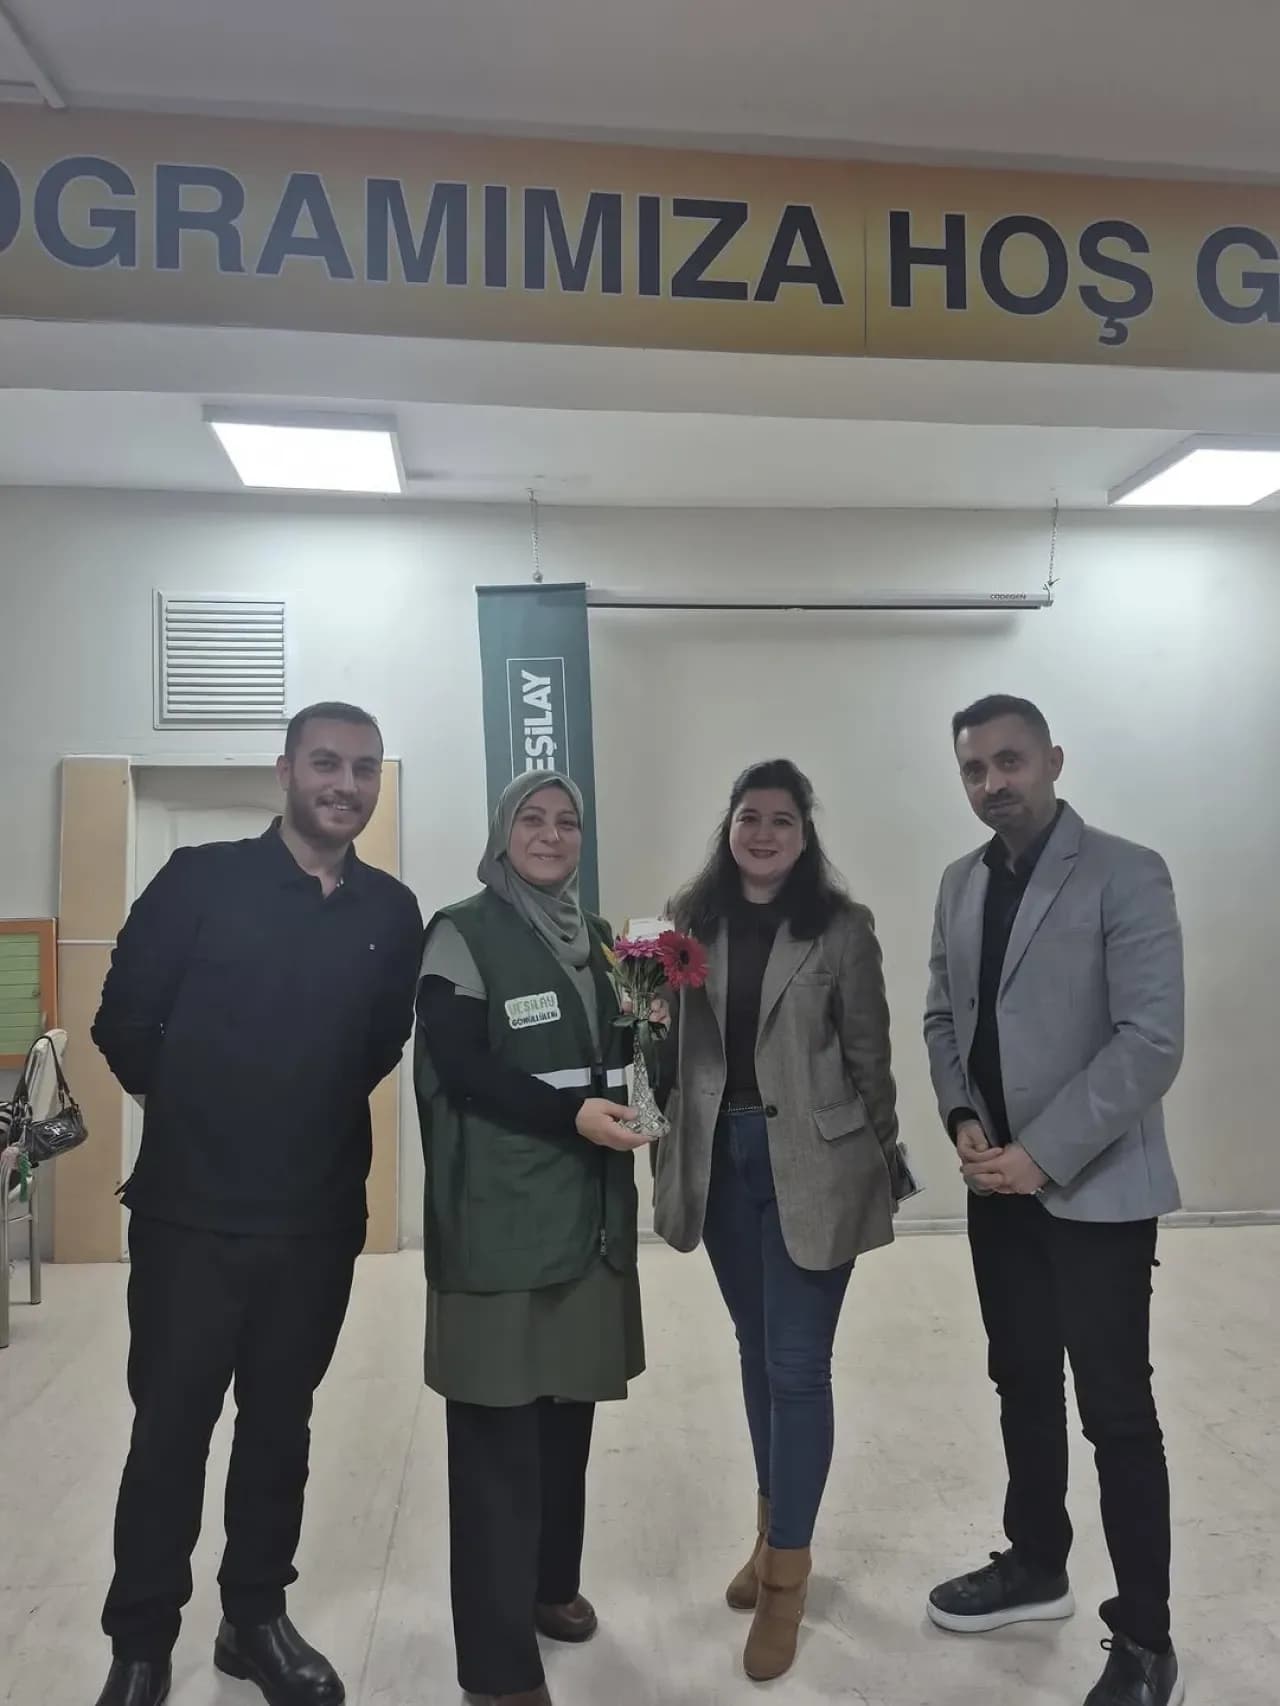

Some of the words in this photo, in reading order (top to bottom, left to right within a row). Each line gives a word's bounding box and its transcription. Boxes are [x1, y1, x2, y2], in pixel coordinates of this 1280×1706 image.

[0, 154, 845, 305] GRAMIMIZA
[888, 210, 1155, 346] HOŞ
[521, 669, 557, 773] EŞİLAY
